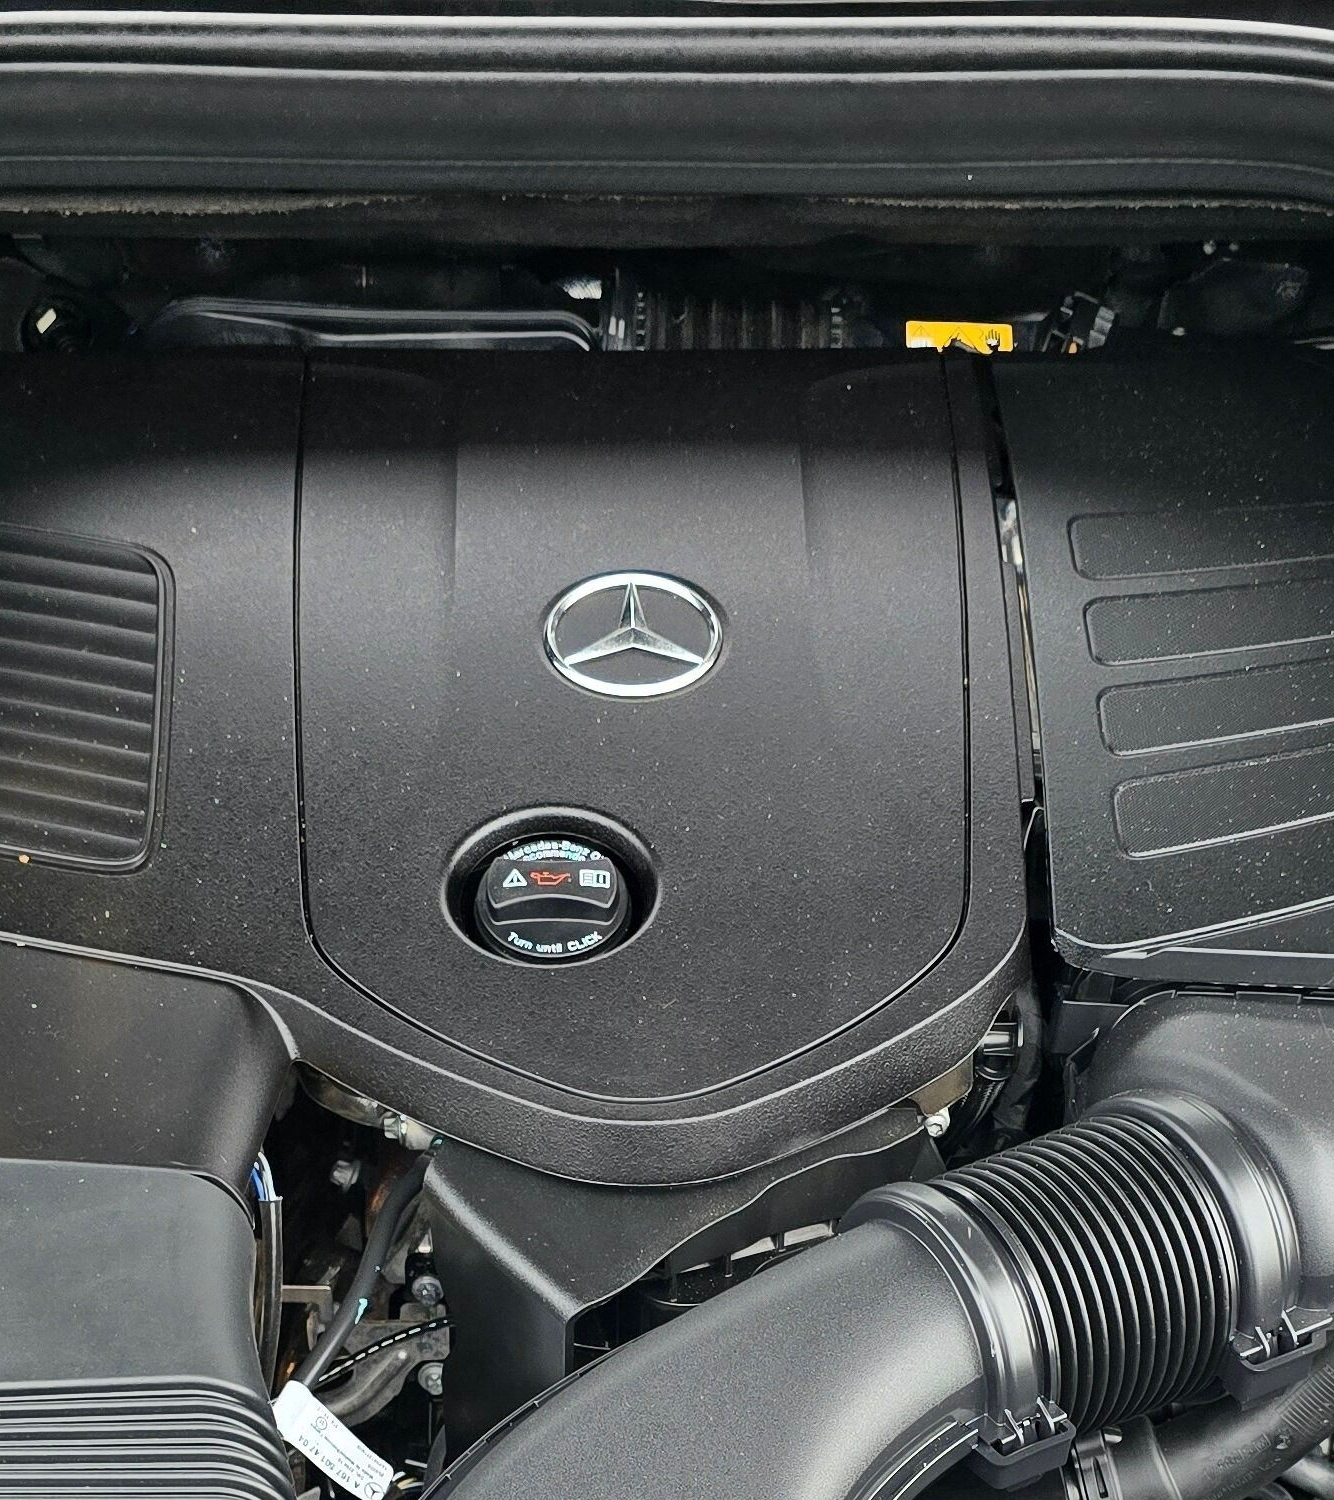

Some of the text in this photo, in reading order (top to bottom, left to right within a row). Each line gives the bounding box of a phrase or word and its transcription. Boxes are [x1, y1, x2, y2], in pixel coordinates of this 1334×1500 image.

[508, 931, 602, 953] Turn until CLICK
